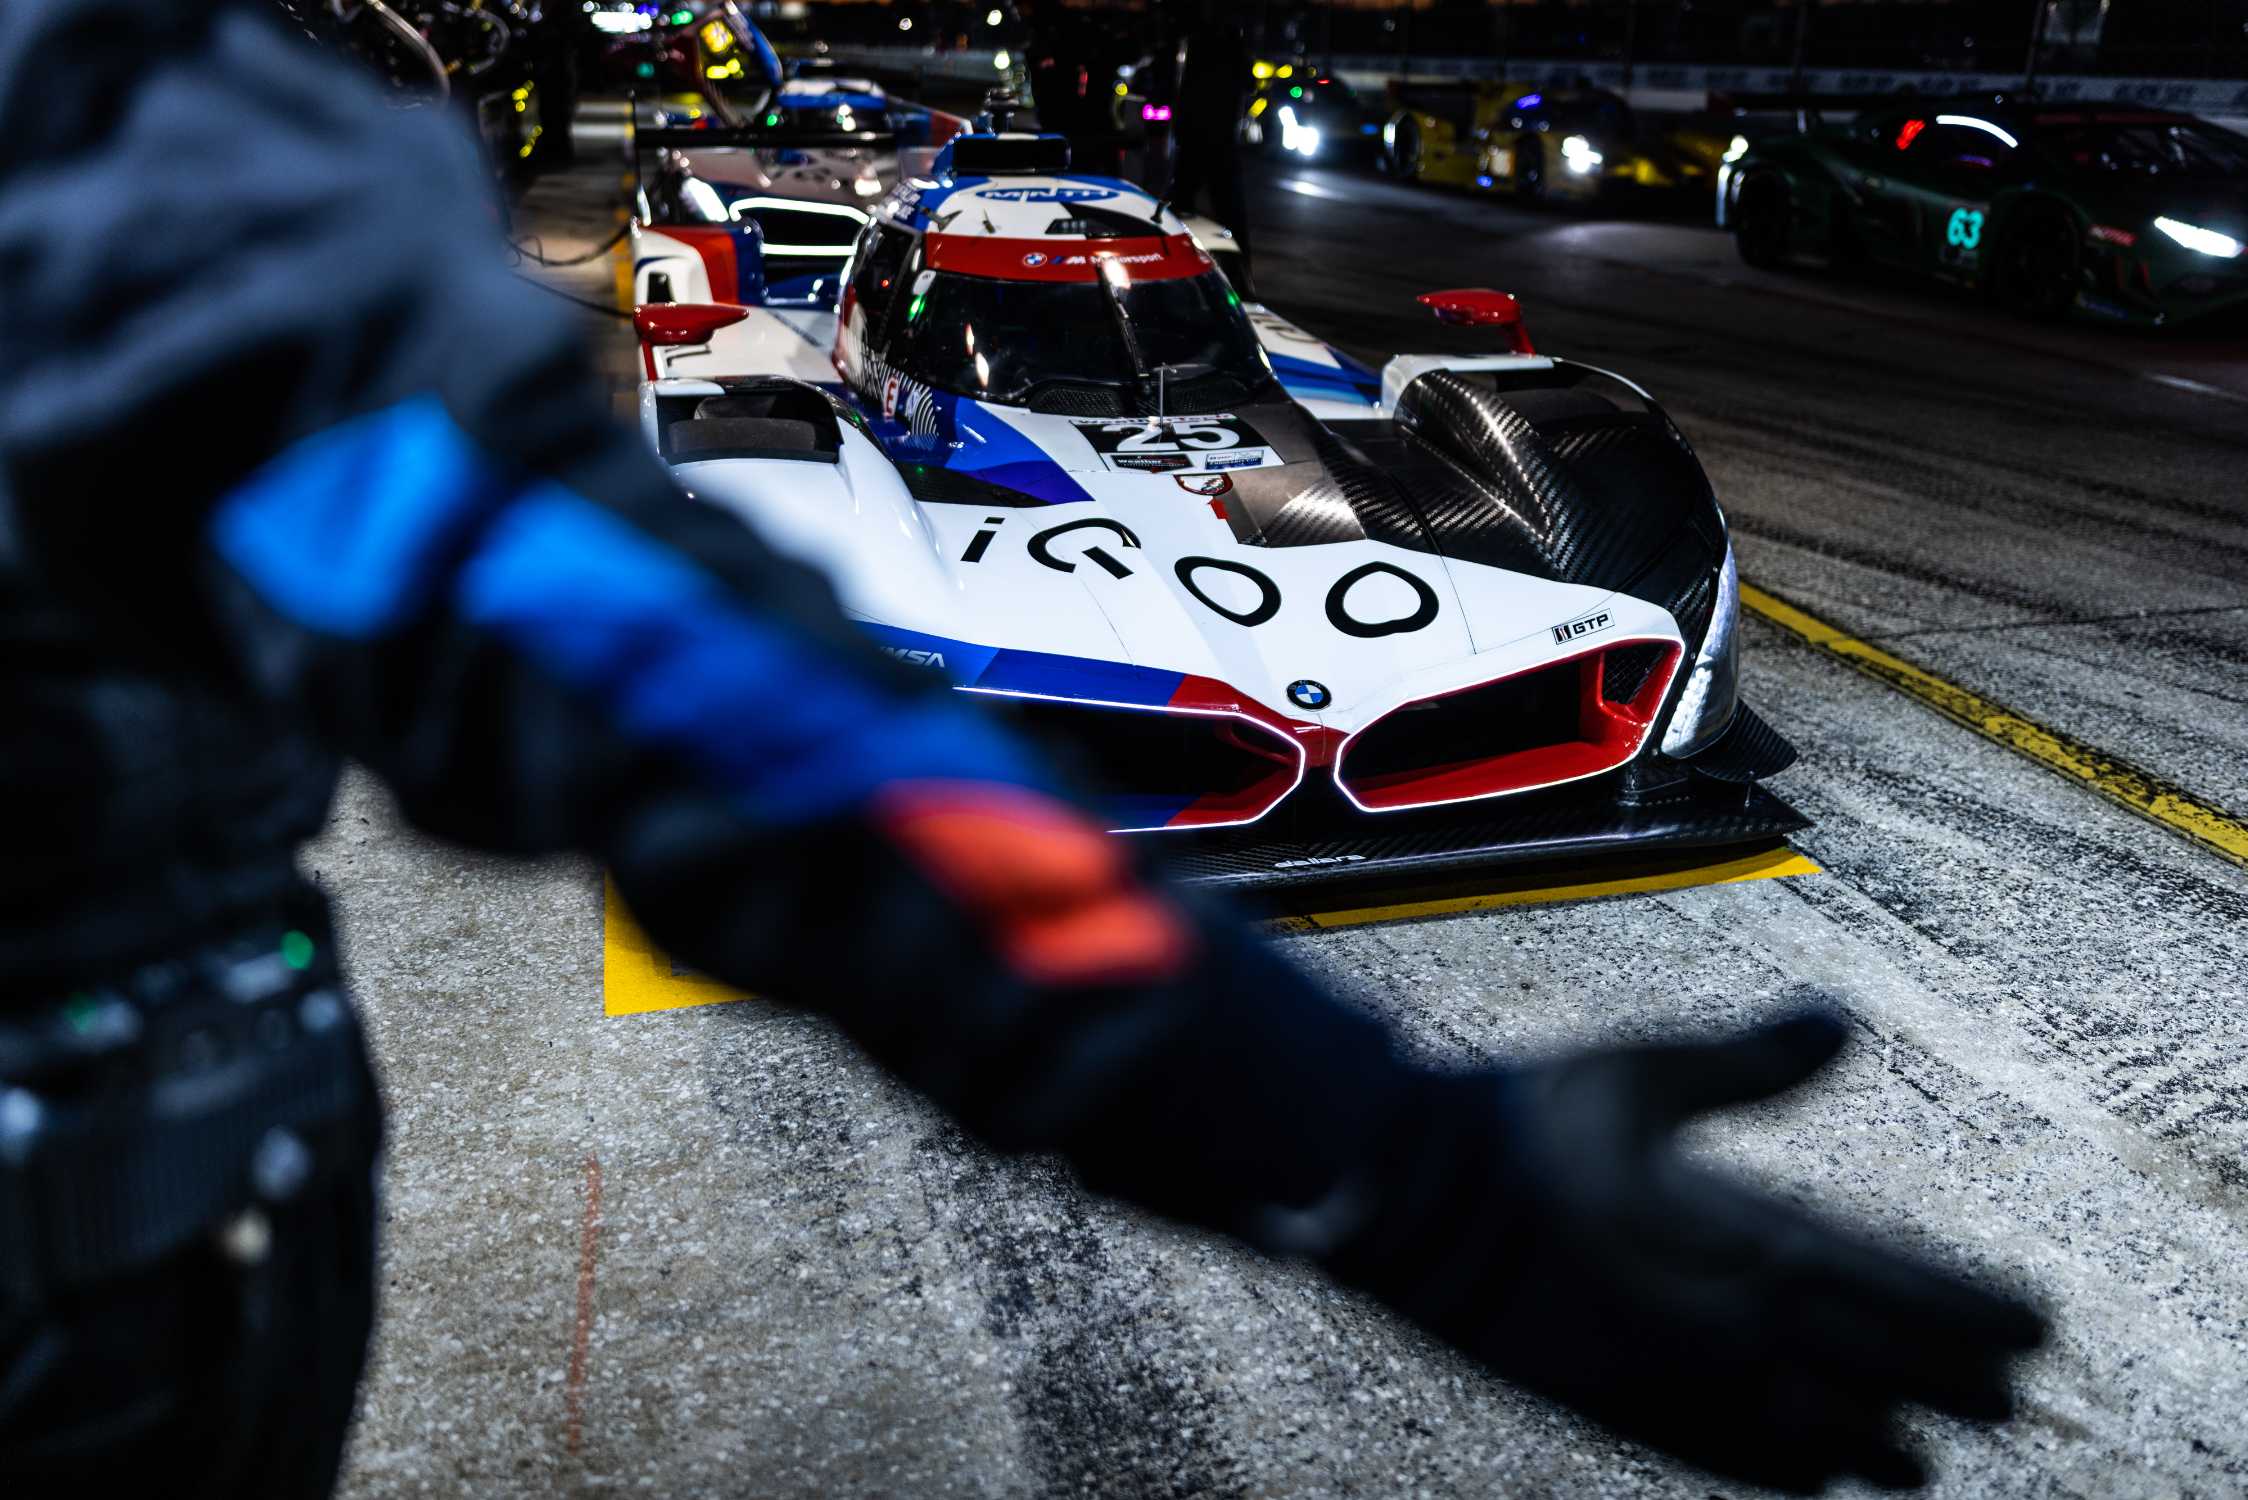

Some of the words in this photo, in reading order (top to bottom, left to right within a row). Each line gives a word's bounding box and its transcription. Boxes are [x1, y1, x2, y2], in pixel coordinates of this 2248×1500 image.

[1946, 207, 1985, 250] 63
[1091, 252, 1164, 265] Morsport
[1102, 421, 1240, 452] 25
[960, 517, 1440, 638] iQOO
[1572, 613, 1609, 635] GTP
